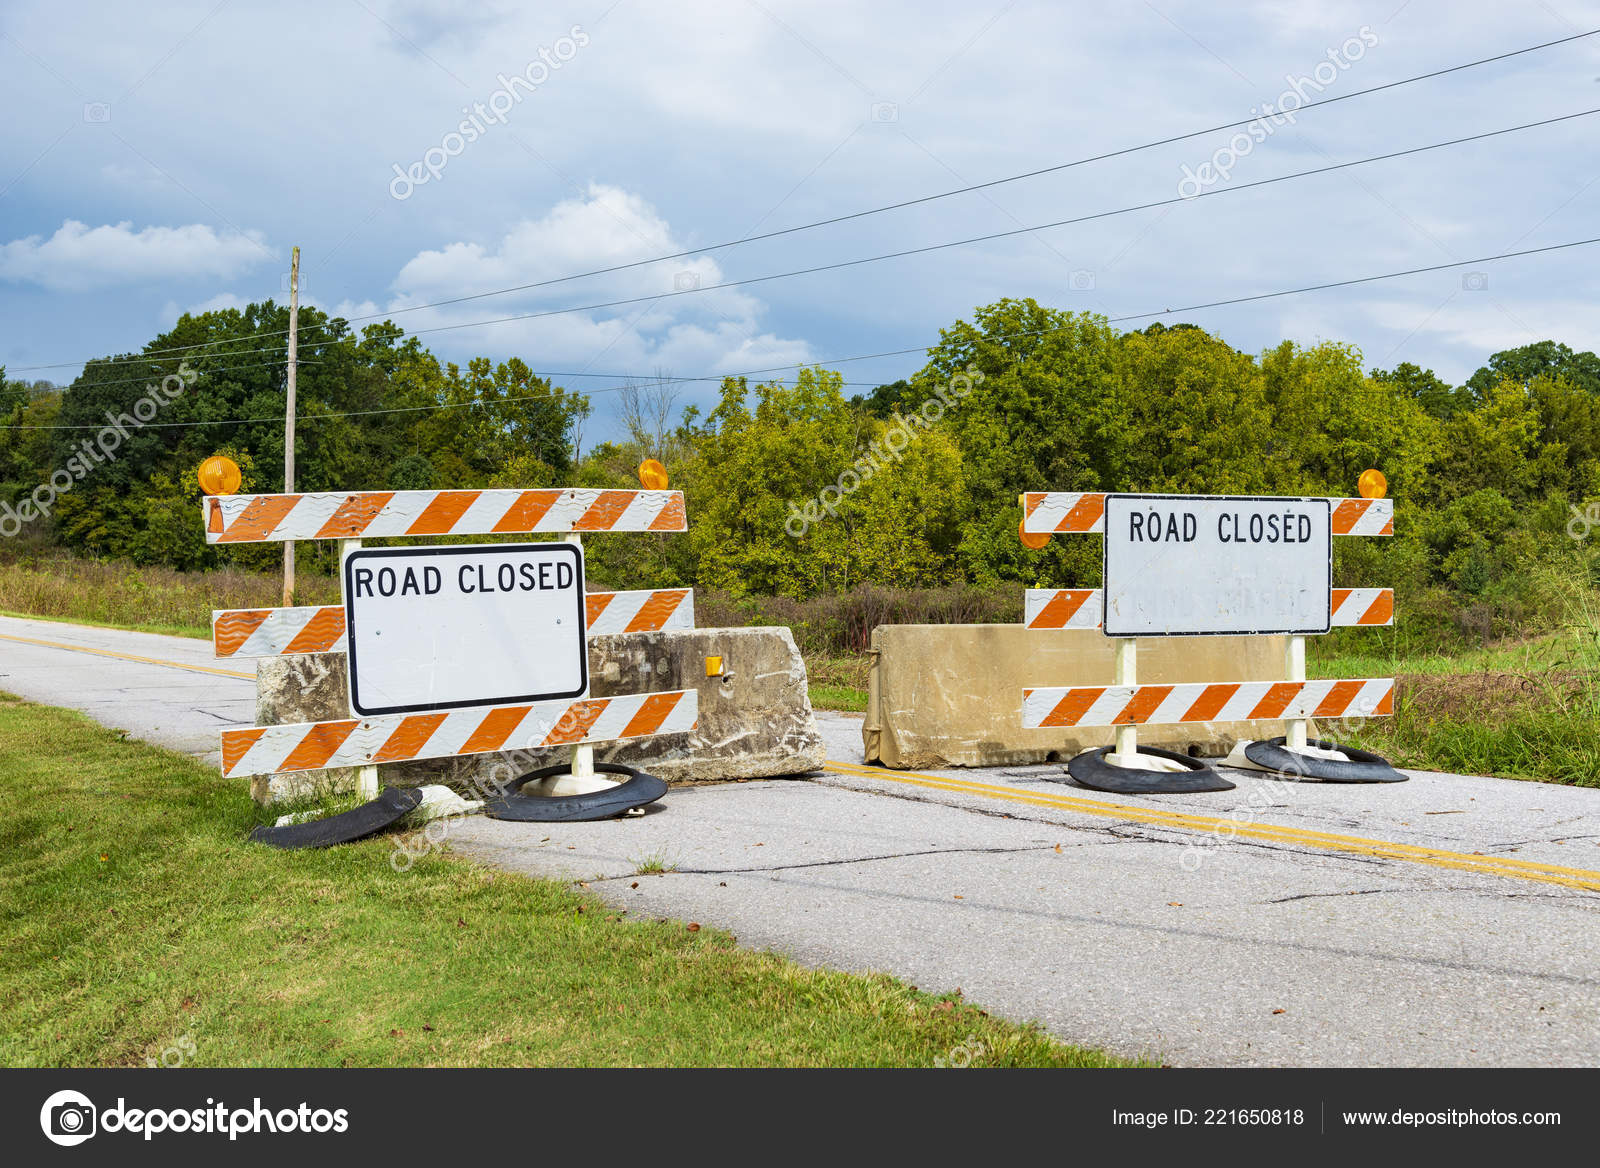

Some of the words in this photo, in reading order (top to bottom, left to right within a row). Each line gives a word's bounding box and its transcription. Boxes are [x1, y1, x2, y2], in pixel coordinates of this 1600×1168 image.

[1130, 512, 1198, 543] ROAD
[1218, 513, 1312, 543] CLOSED
[355, 566, 442, 598] ROAD
[458, 562, 573, 593] CLOSED
